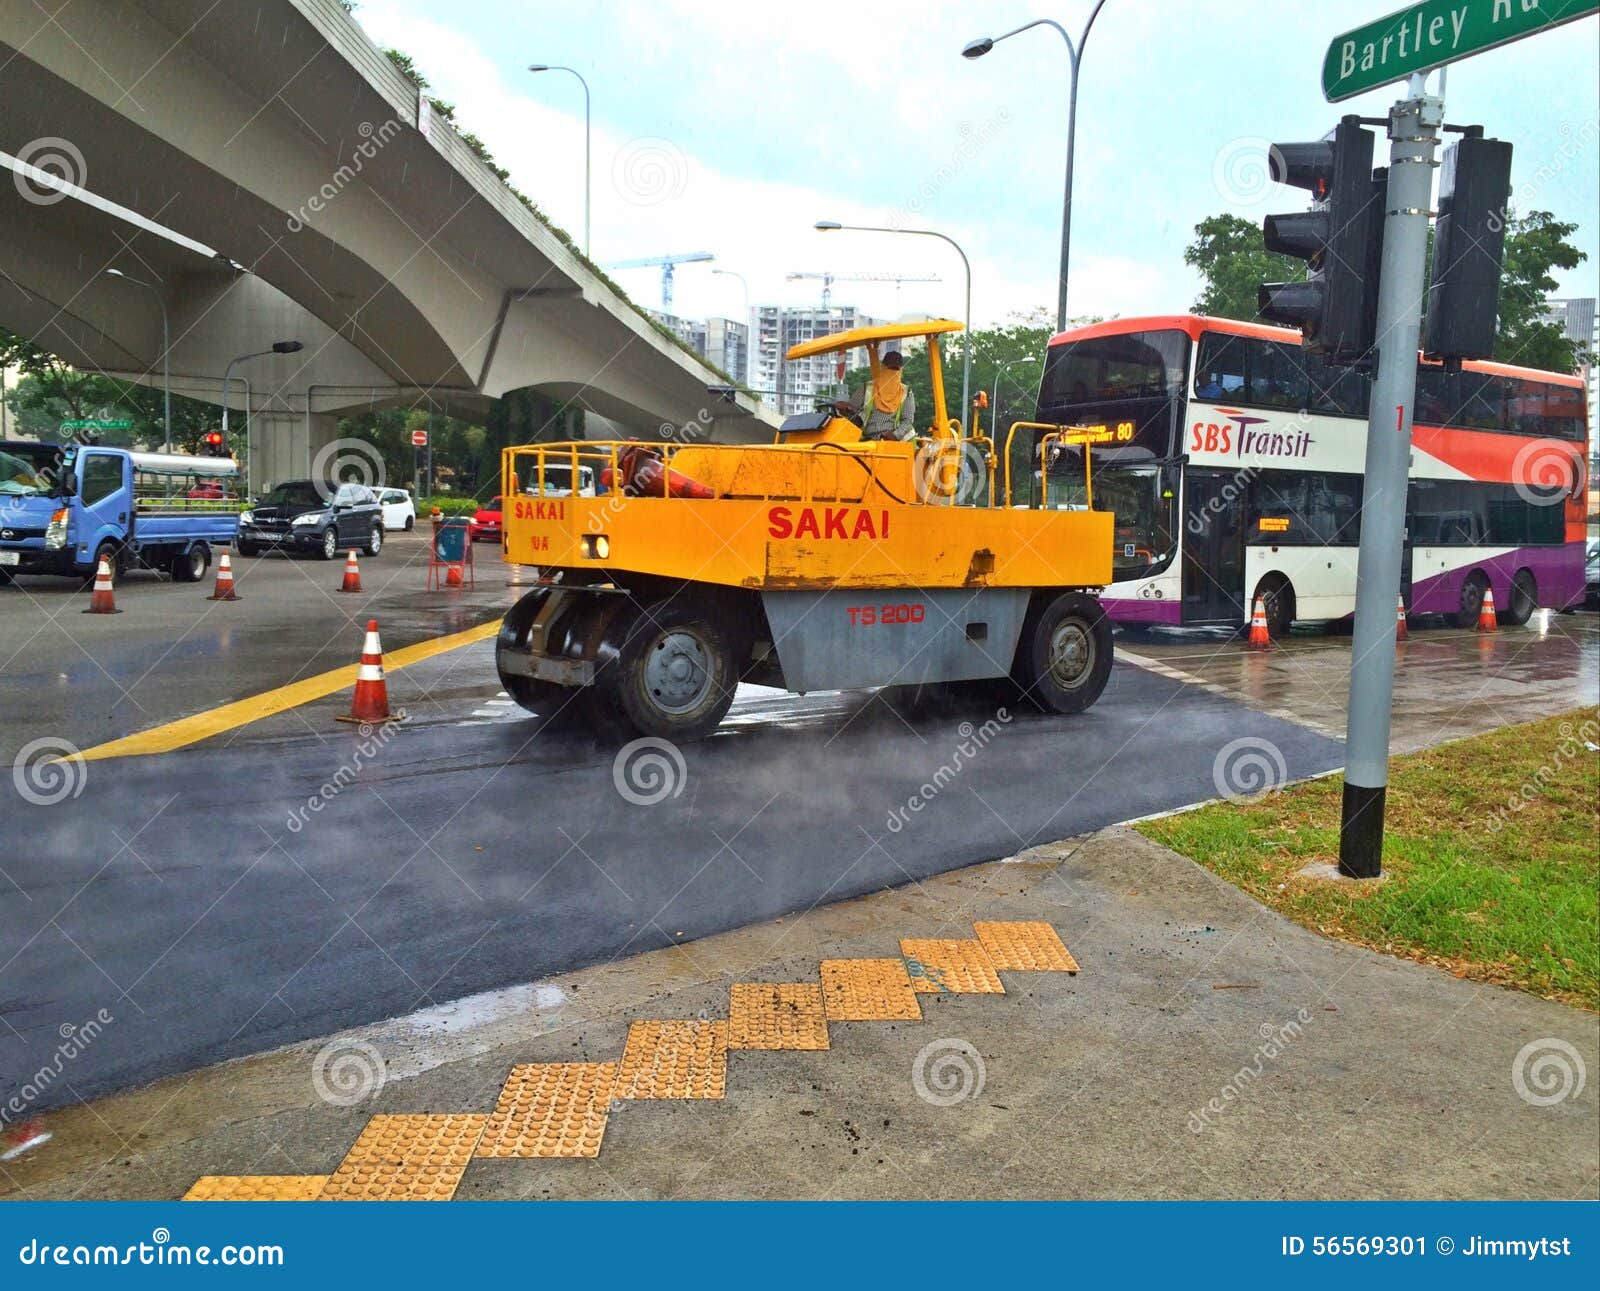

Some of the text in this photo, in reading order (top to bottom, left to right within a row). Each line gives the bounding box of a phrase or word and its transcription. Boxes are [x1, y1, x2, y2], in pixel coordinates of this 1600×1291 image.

[1340, 6, 1467, 80] Bartley
[1396, 405, 1404, 431] 1
[1117, 422, 1133, 441] 80
[1191, 416, 1317, 460] SBS Transit
[515, 501, 564, 520] SAKAI
[768, 506, 889, 540] SAKAI
[846, 604, 925, 626] TS 200
